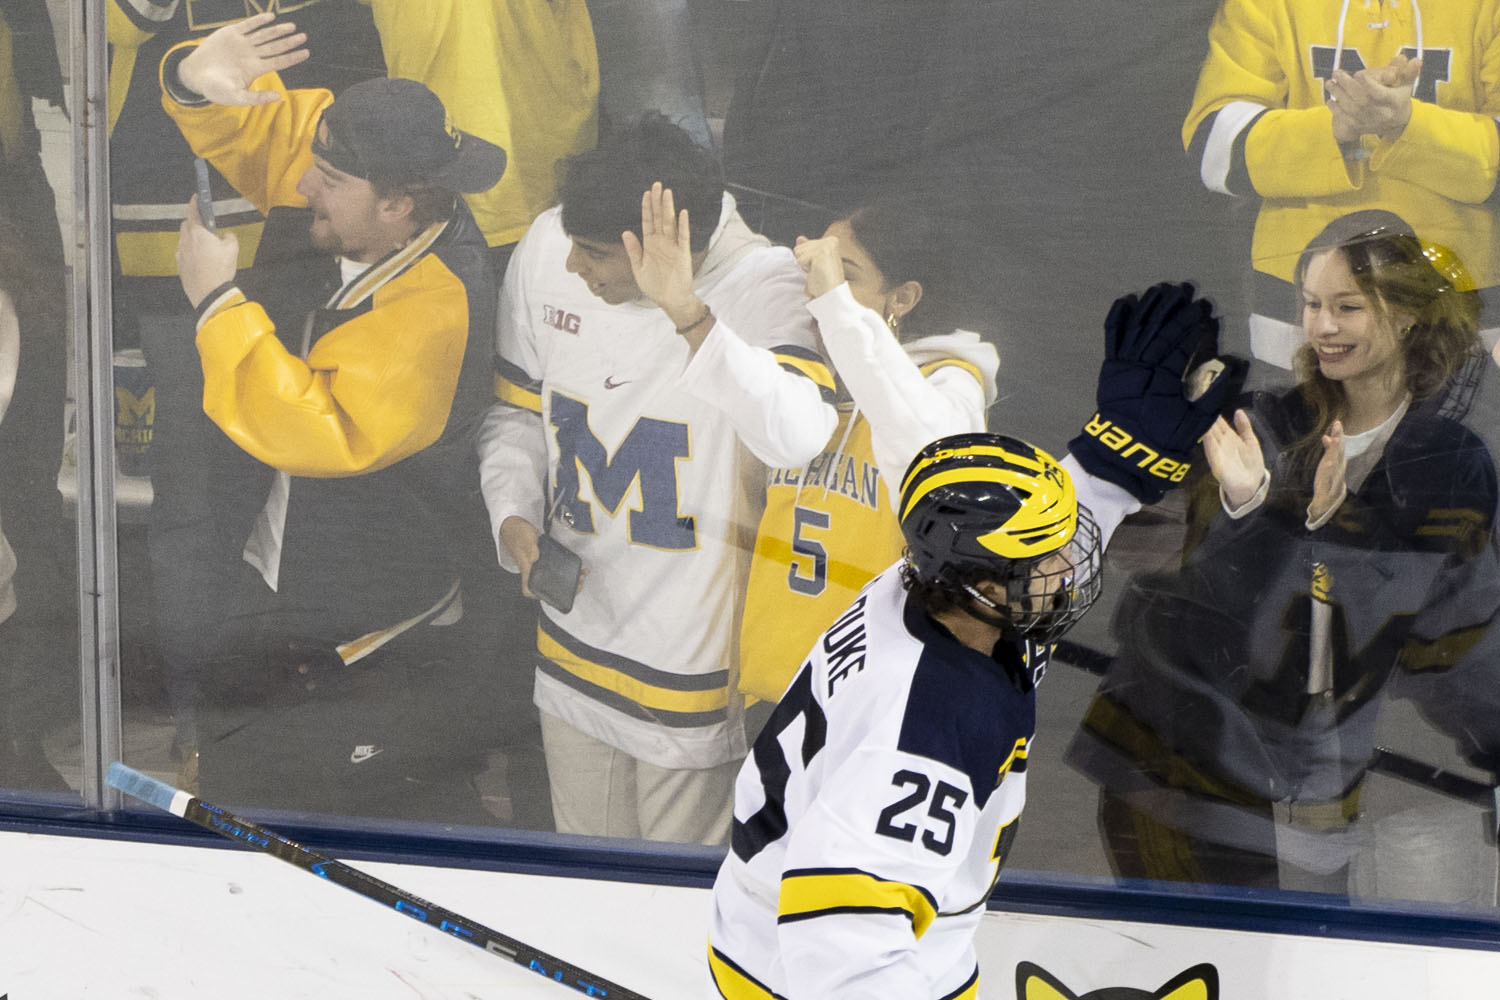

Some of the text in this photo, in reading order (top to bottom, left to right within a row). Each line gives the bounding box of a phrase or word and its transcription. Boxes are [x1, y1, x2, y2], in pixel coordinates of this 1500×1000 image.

[550, 388, 703, 552] M
[788, 505, 830, 598] 5
[875, 769, 968, 857] 25
